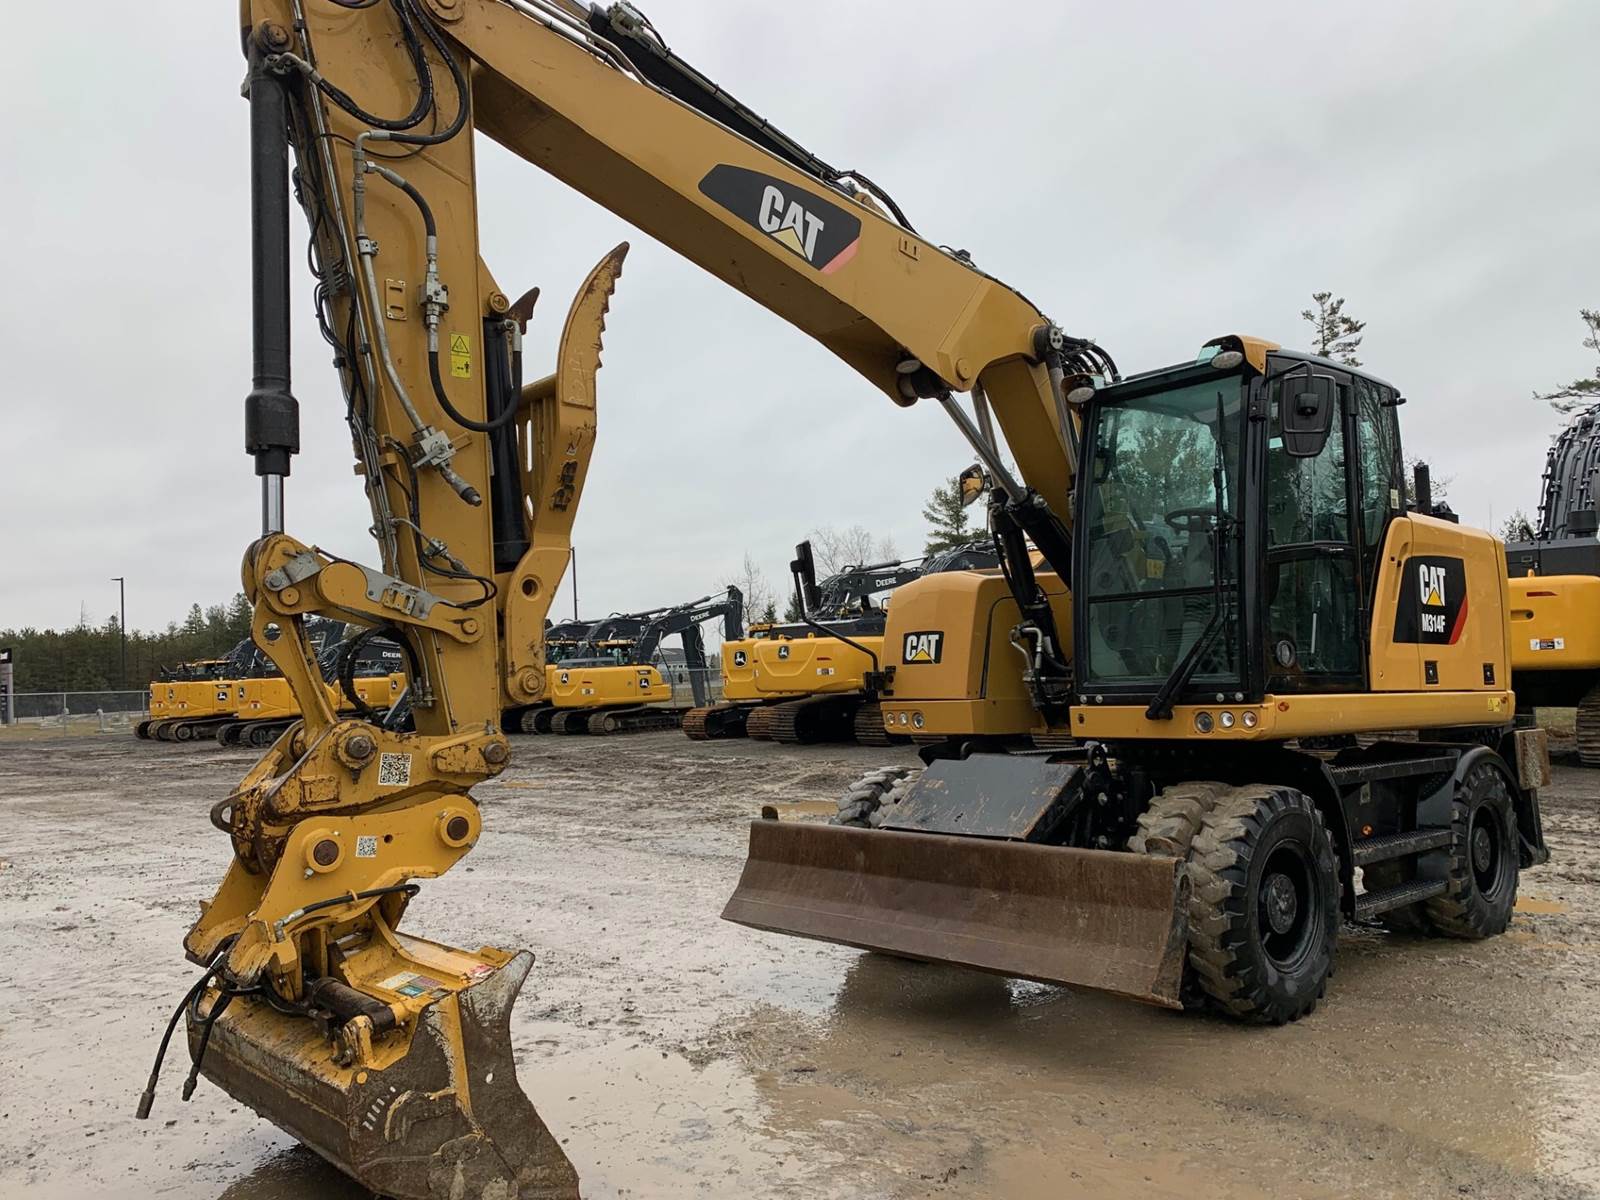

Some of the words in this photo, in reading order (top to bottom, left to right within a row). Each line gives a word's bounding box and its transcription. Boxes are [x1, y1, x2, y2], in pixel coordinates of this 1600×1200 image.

[758, 185, 824, 262] CAT
[876, 577, 897, 588] DEERE
[1419, 563, 1446, 607] CAT
[1421, 613, 1446, 633] M314F
[905, 634, 940, 661] CAT
